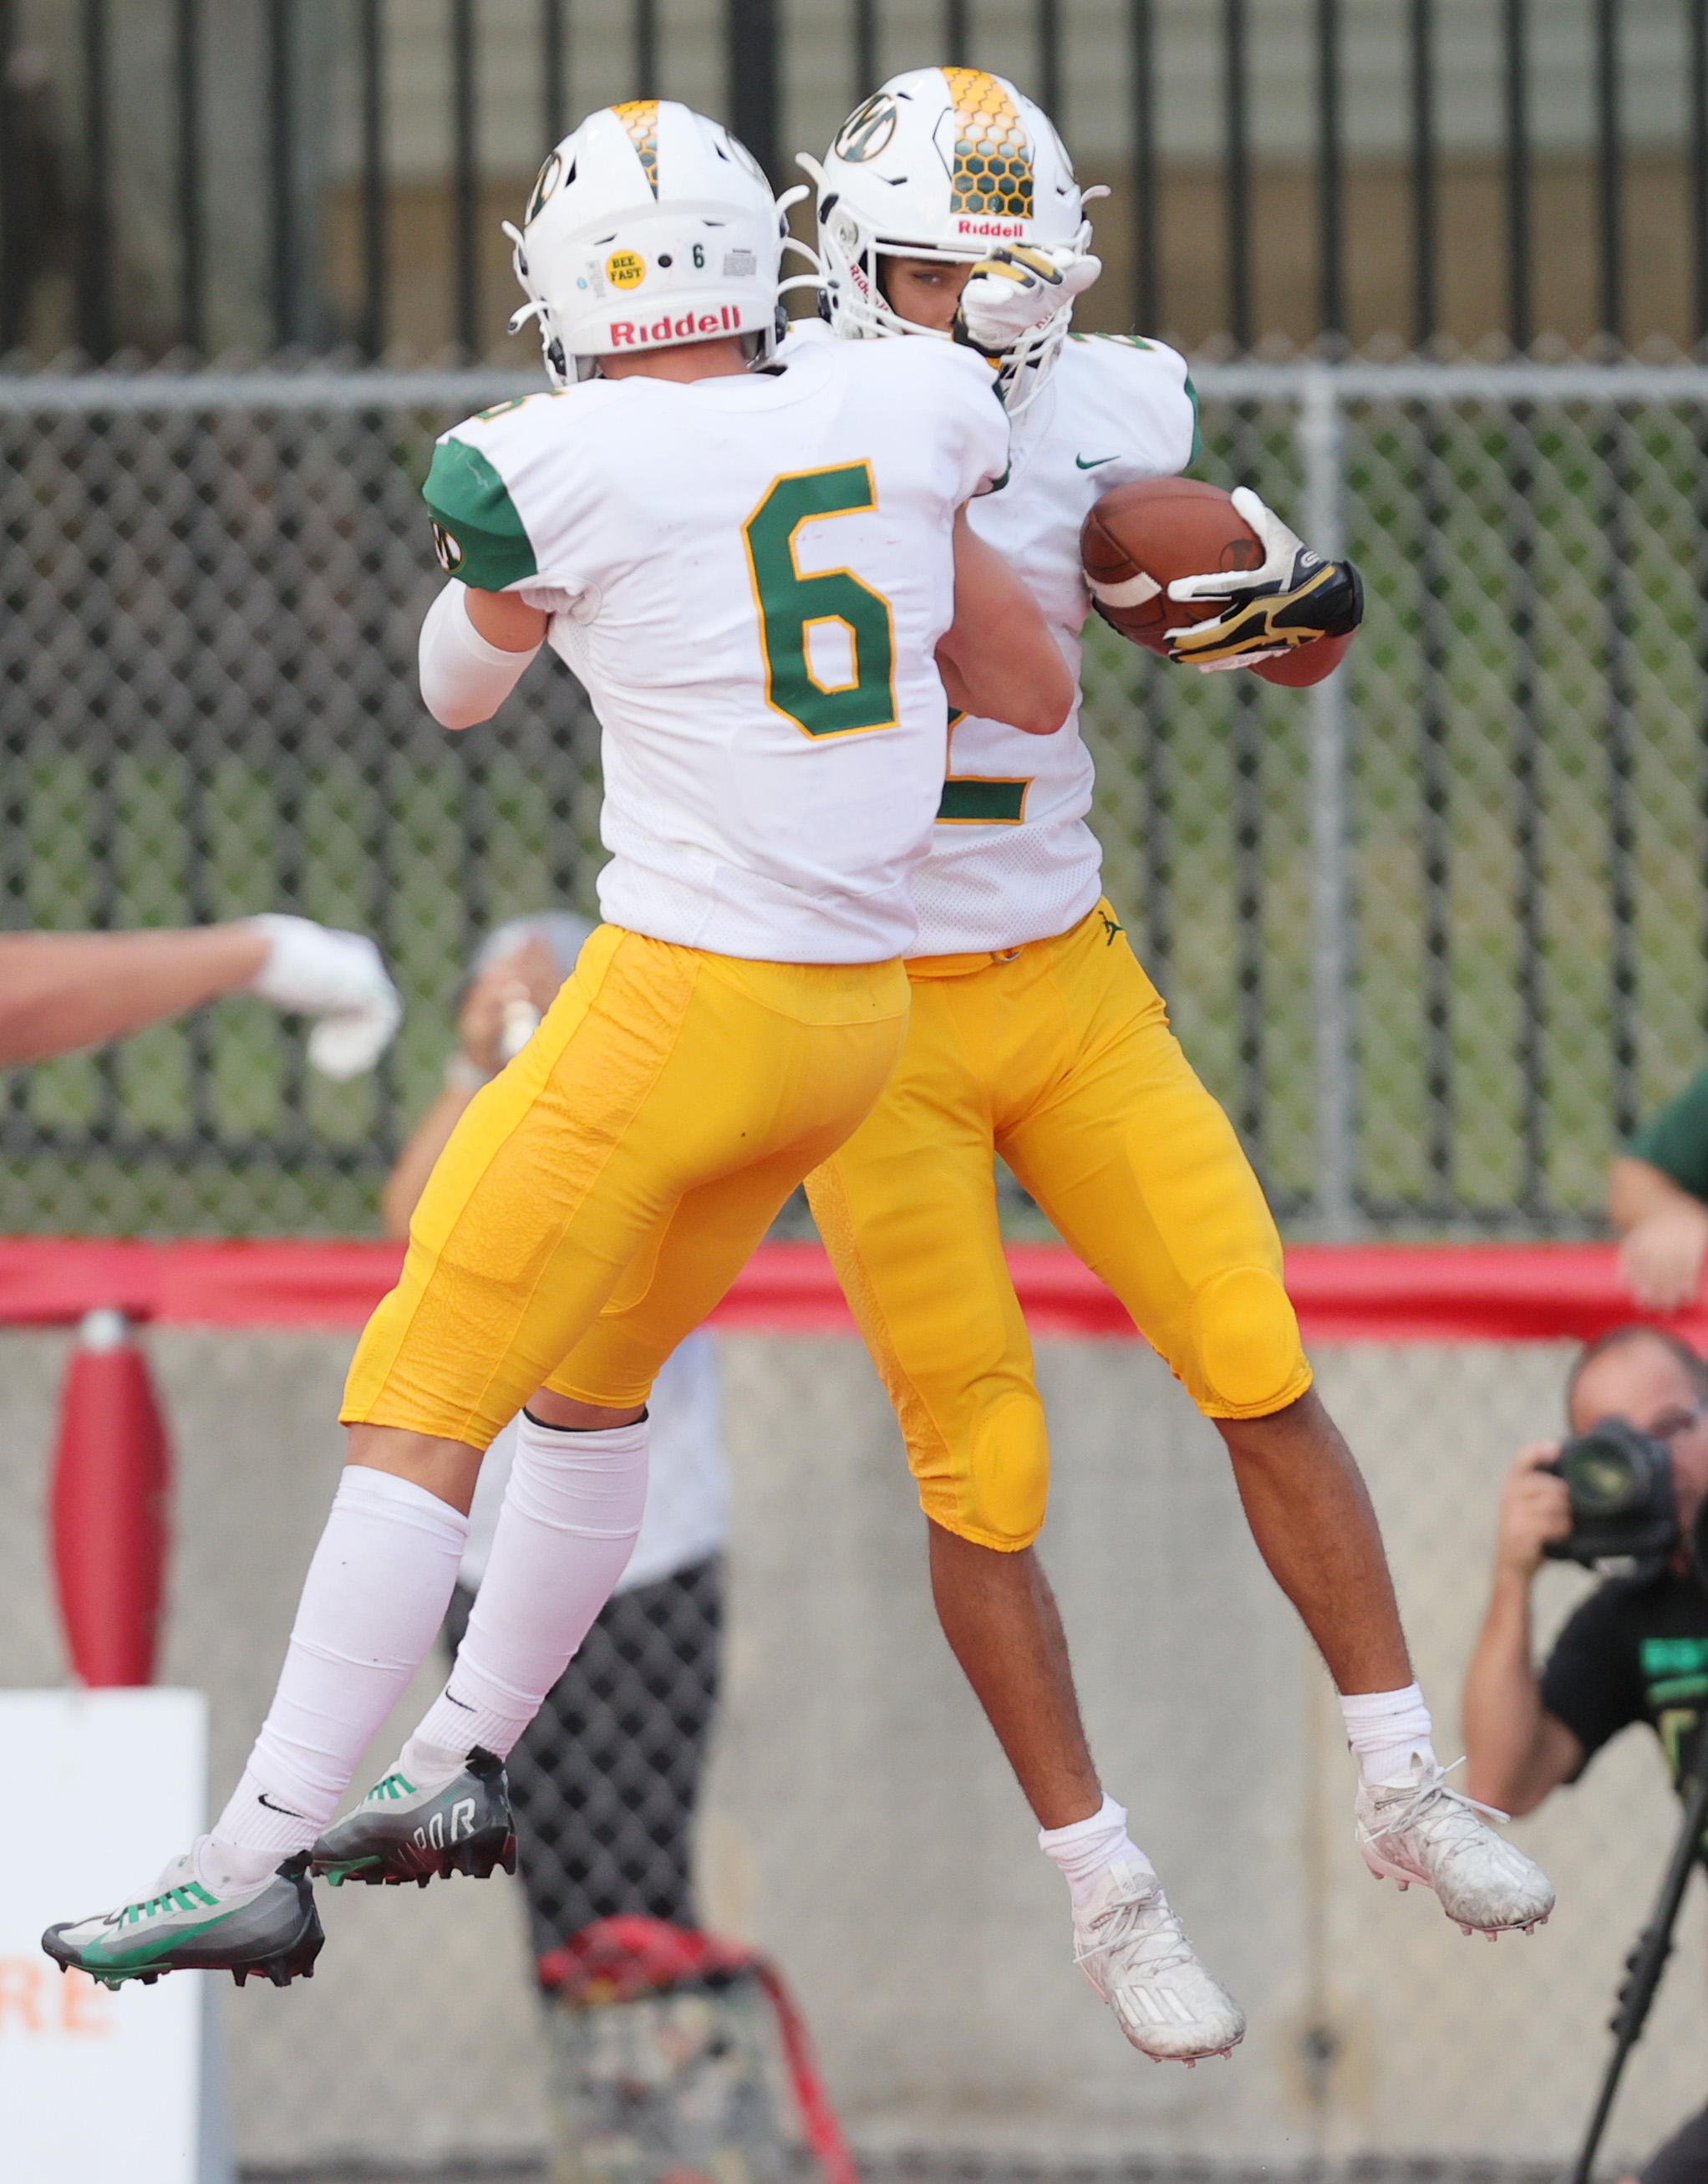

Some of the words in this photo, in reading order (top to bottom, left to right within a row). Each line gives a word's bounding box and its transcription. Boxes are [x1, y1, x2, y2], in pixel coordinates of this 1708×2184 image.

[958, 220, 1023, 237] Riddell
[612, 255, 635, 268] BEE
[693, 243, 704, 268] 6
[610, 267, 642, 282] FAST
[609, 304, 740, 347] Riddell
[741, 457, 900, 741] 6
